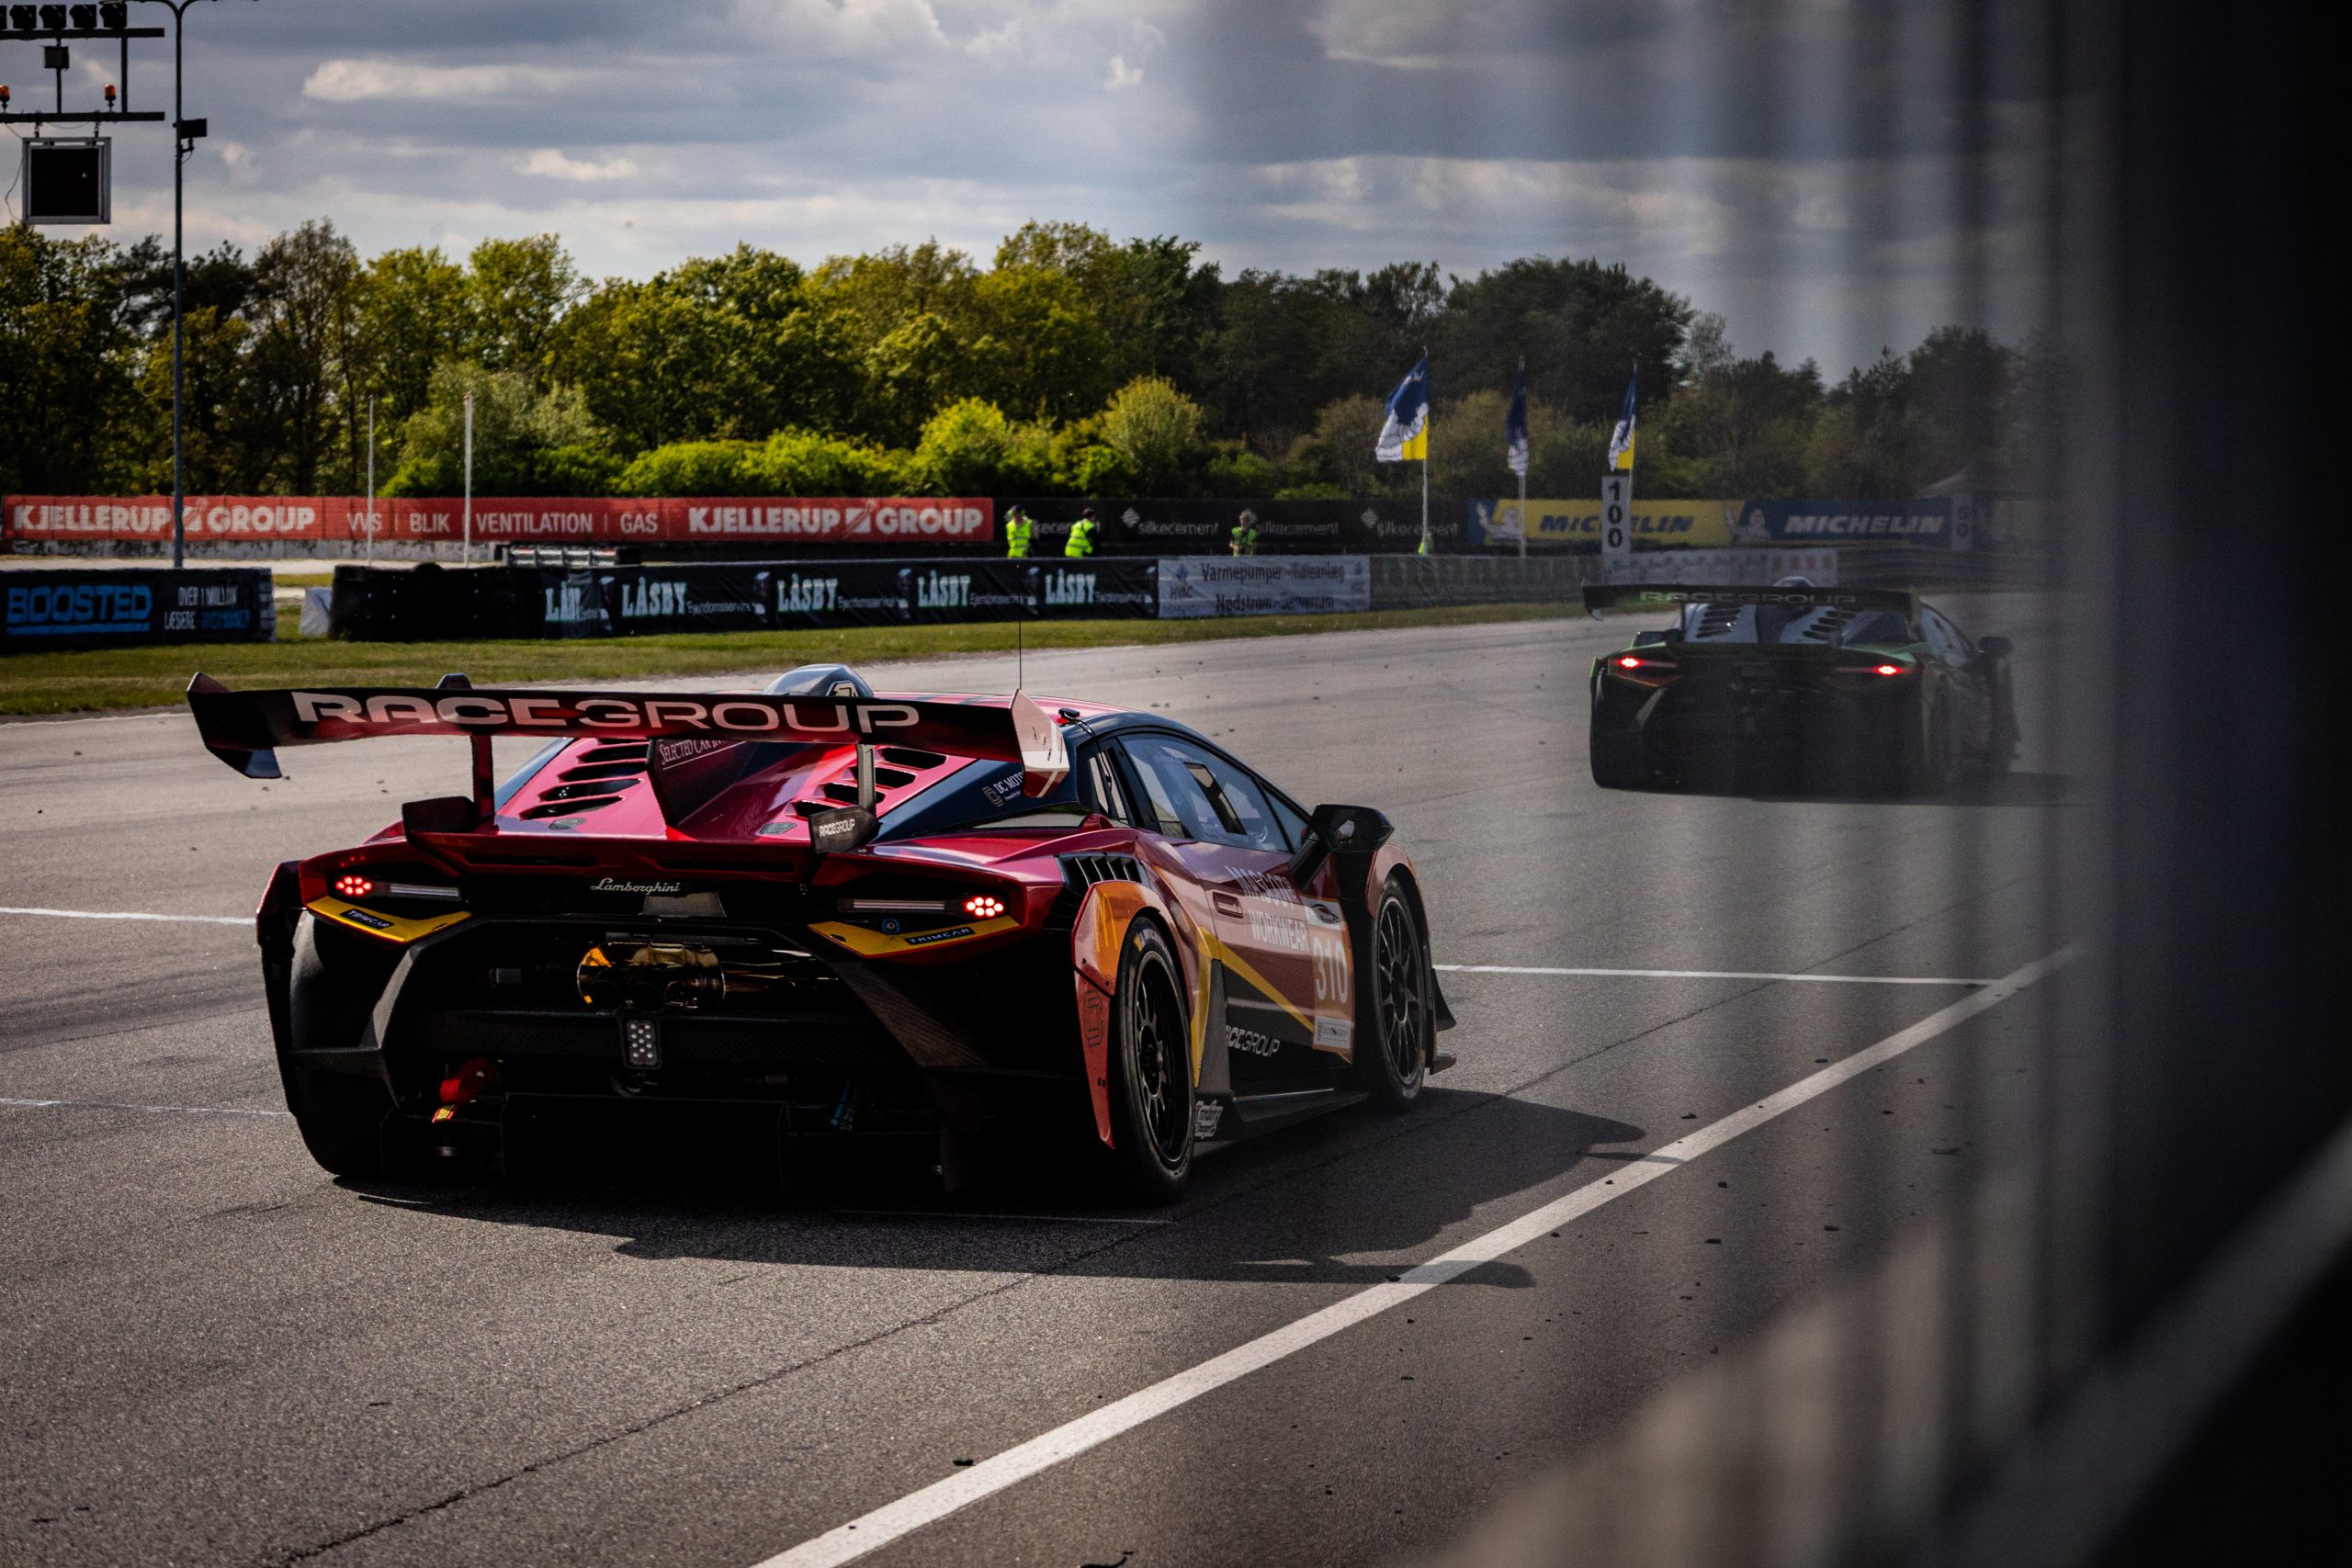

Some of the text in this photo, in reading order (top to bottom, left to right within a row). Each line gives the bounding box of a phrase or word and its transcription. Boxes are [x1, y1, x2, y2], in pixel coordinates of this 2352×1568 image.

[13, 504, 315, 533] KJELLERUP GROUP
[410, 512, 451, 533] BLIK
[476, 512, 594, 533] VENTILATION
[620, 513, 658, 534] GAS
[689, 507, 983, 534] KJELLERUP GROUP
[1138, 521, 1219, 536] silkecement
[1539, 514, 1694, 533] MICELIN
[1608, 481, 1623, 547] 100
[1784, 514, 1945, 534] MICHELIN
[177, 586, 198, 606] OVER
[621, 576, 687, 617] LÅSBY
[777, 572, 838, 613] LÅSBY
[917, 569, 971, 607] LÅSBY
[1045, 568, 1097, 604] LÅSBY
[6, 584, 153, 623] BOOSTED
[290, 692, 920, 733] RACEGROUP
[819, 818, 855, 837] RACEGROUP
[591, 877, 681, 895] Lamborghini
[908, 928, 971, 944] TRIMCAR
[1248, 909, 1309, 952] WORKWEAR
[1313, 936, 1350, 1004] 310
